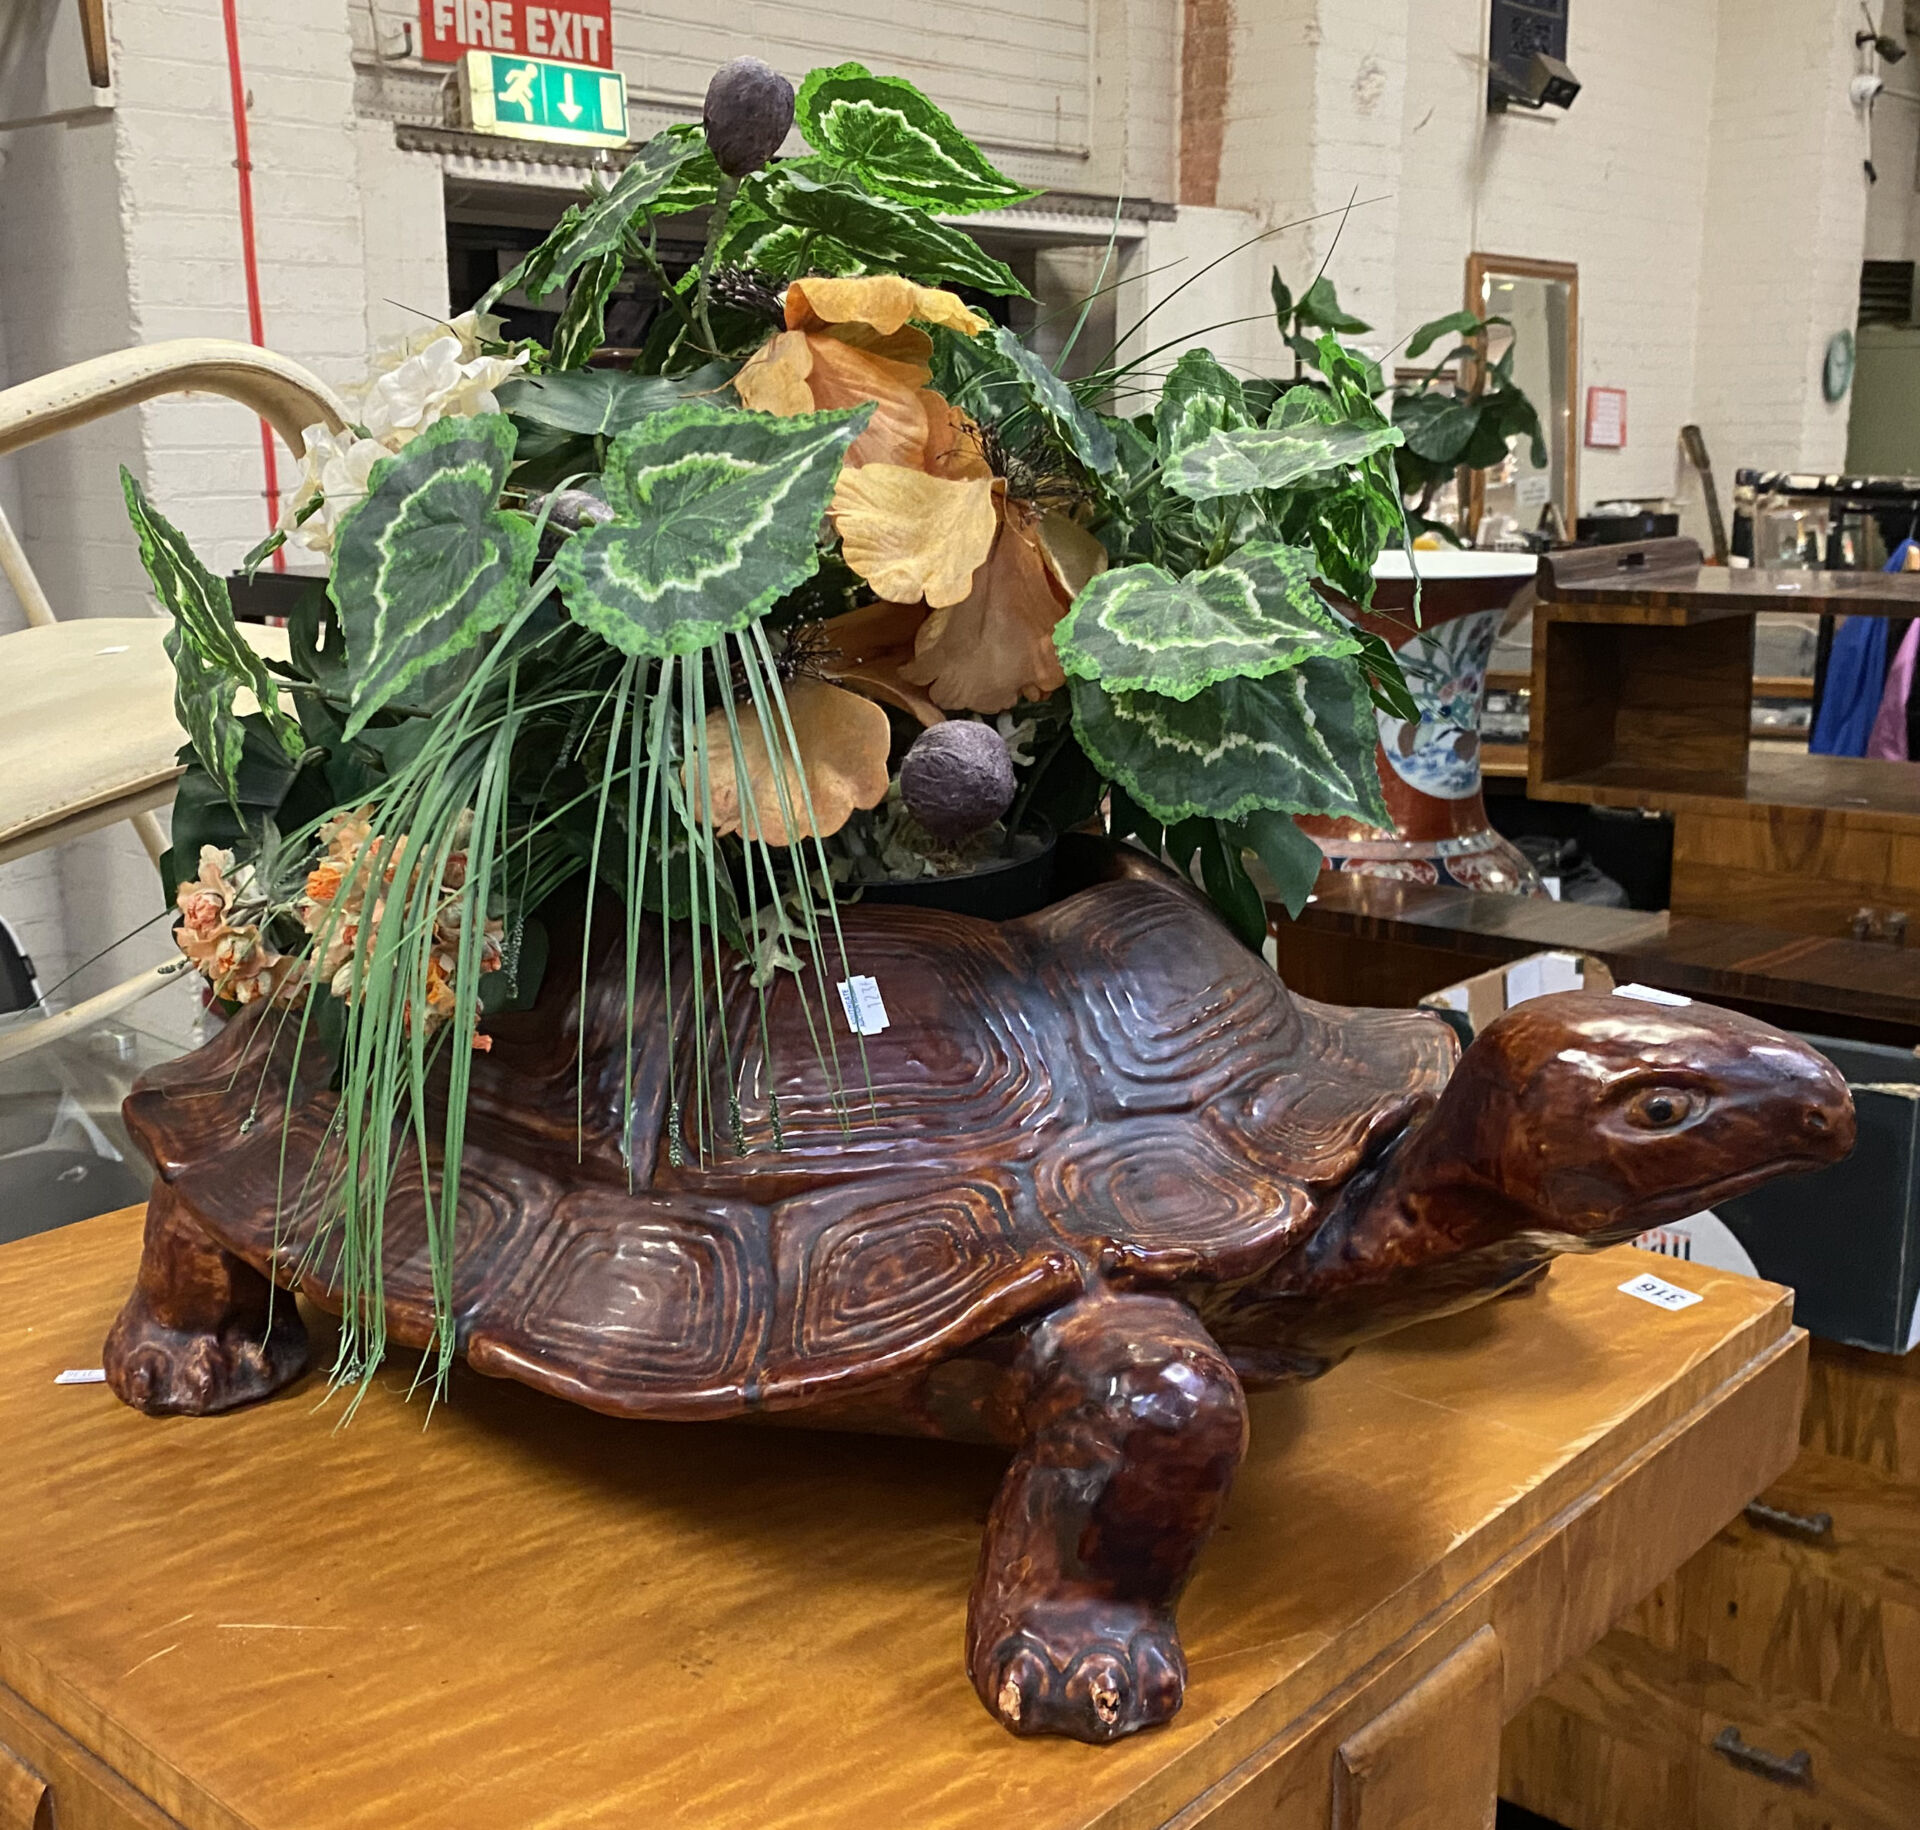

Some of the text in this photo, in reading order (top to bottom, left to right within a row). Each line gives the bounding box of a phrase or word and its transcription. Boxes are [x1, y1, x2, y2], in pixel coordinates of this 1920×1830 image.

[433, 0, 605, 62] FIRE EXIT
[1637, 1282, 1686, 1304] 316
